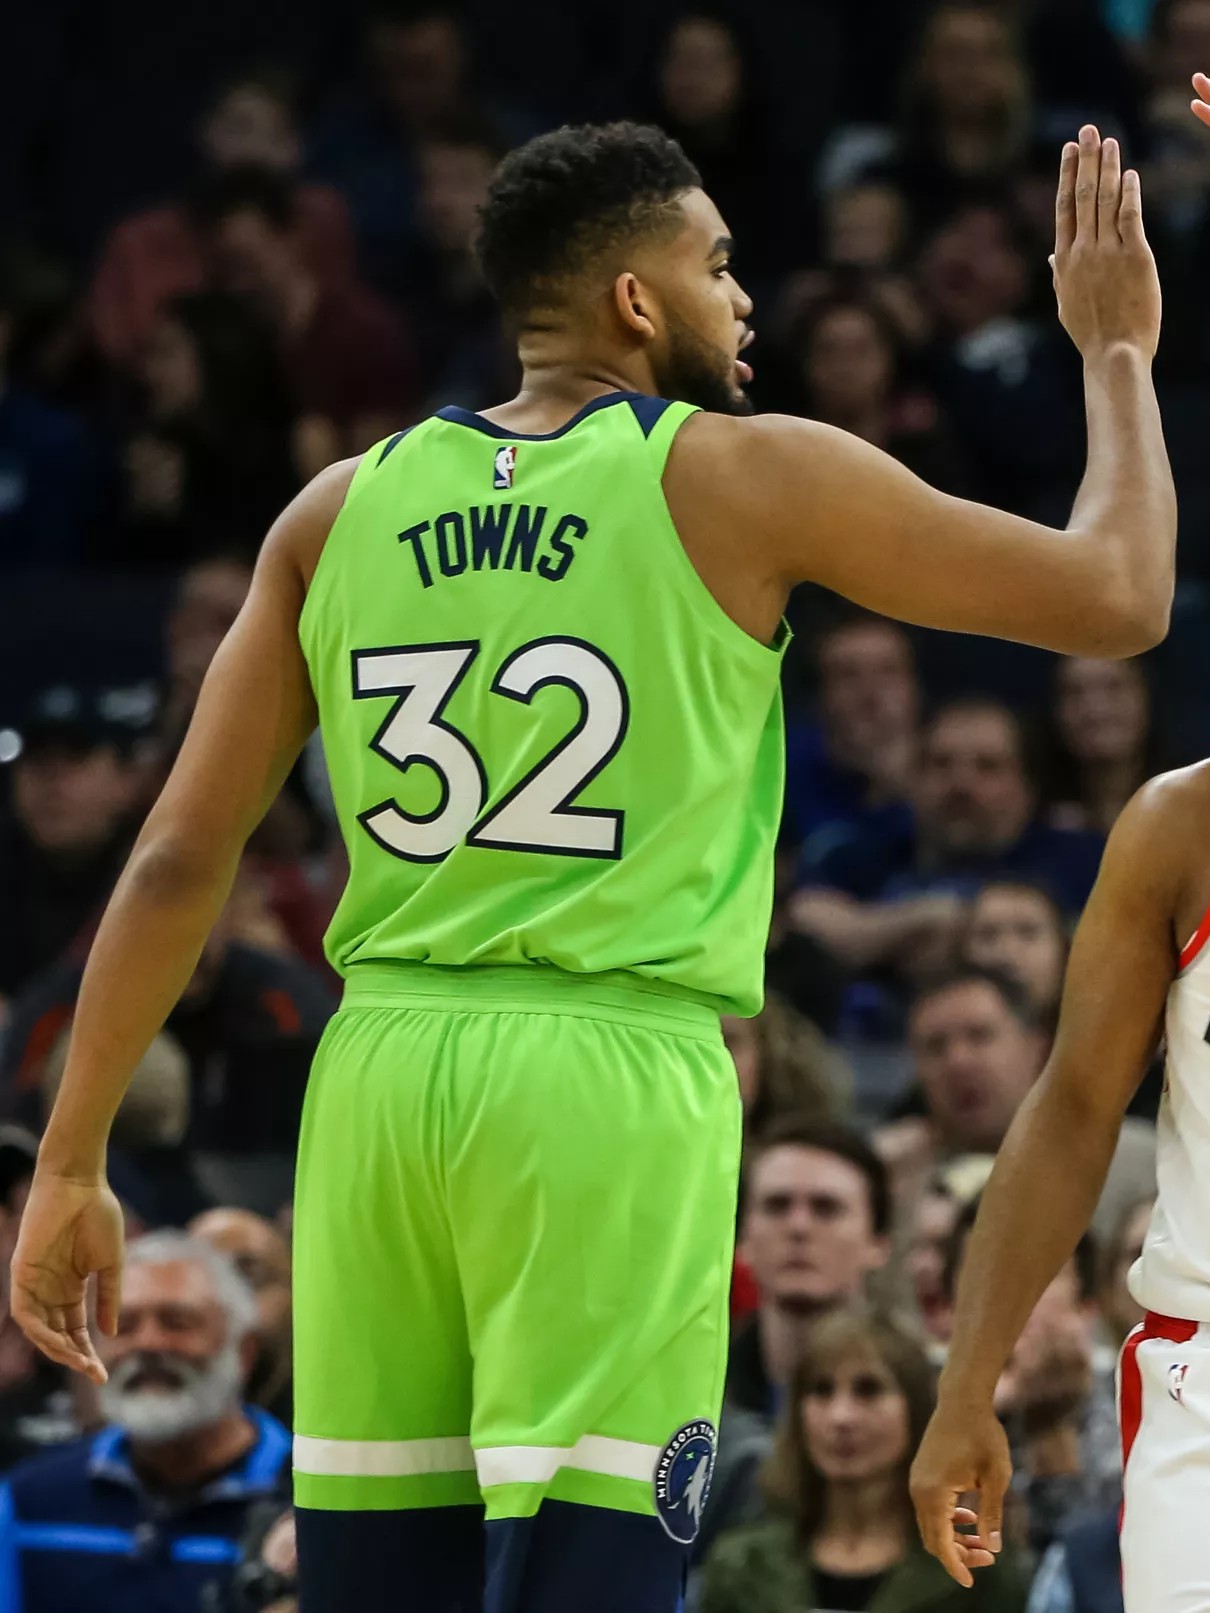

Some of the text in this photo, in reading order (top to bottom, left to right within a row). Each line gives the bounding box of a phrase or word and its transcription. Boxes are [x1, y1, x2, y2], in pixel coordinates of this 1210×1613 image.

[398, 503, 589, 589] TOWNS
[350, 635, 630, 864] 32
[657, 1426, 698, 1498] MINNESOTA
